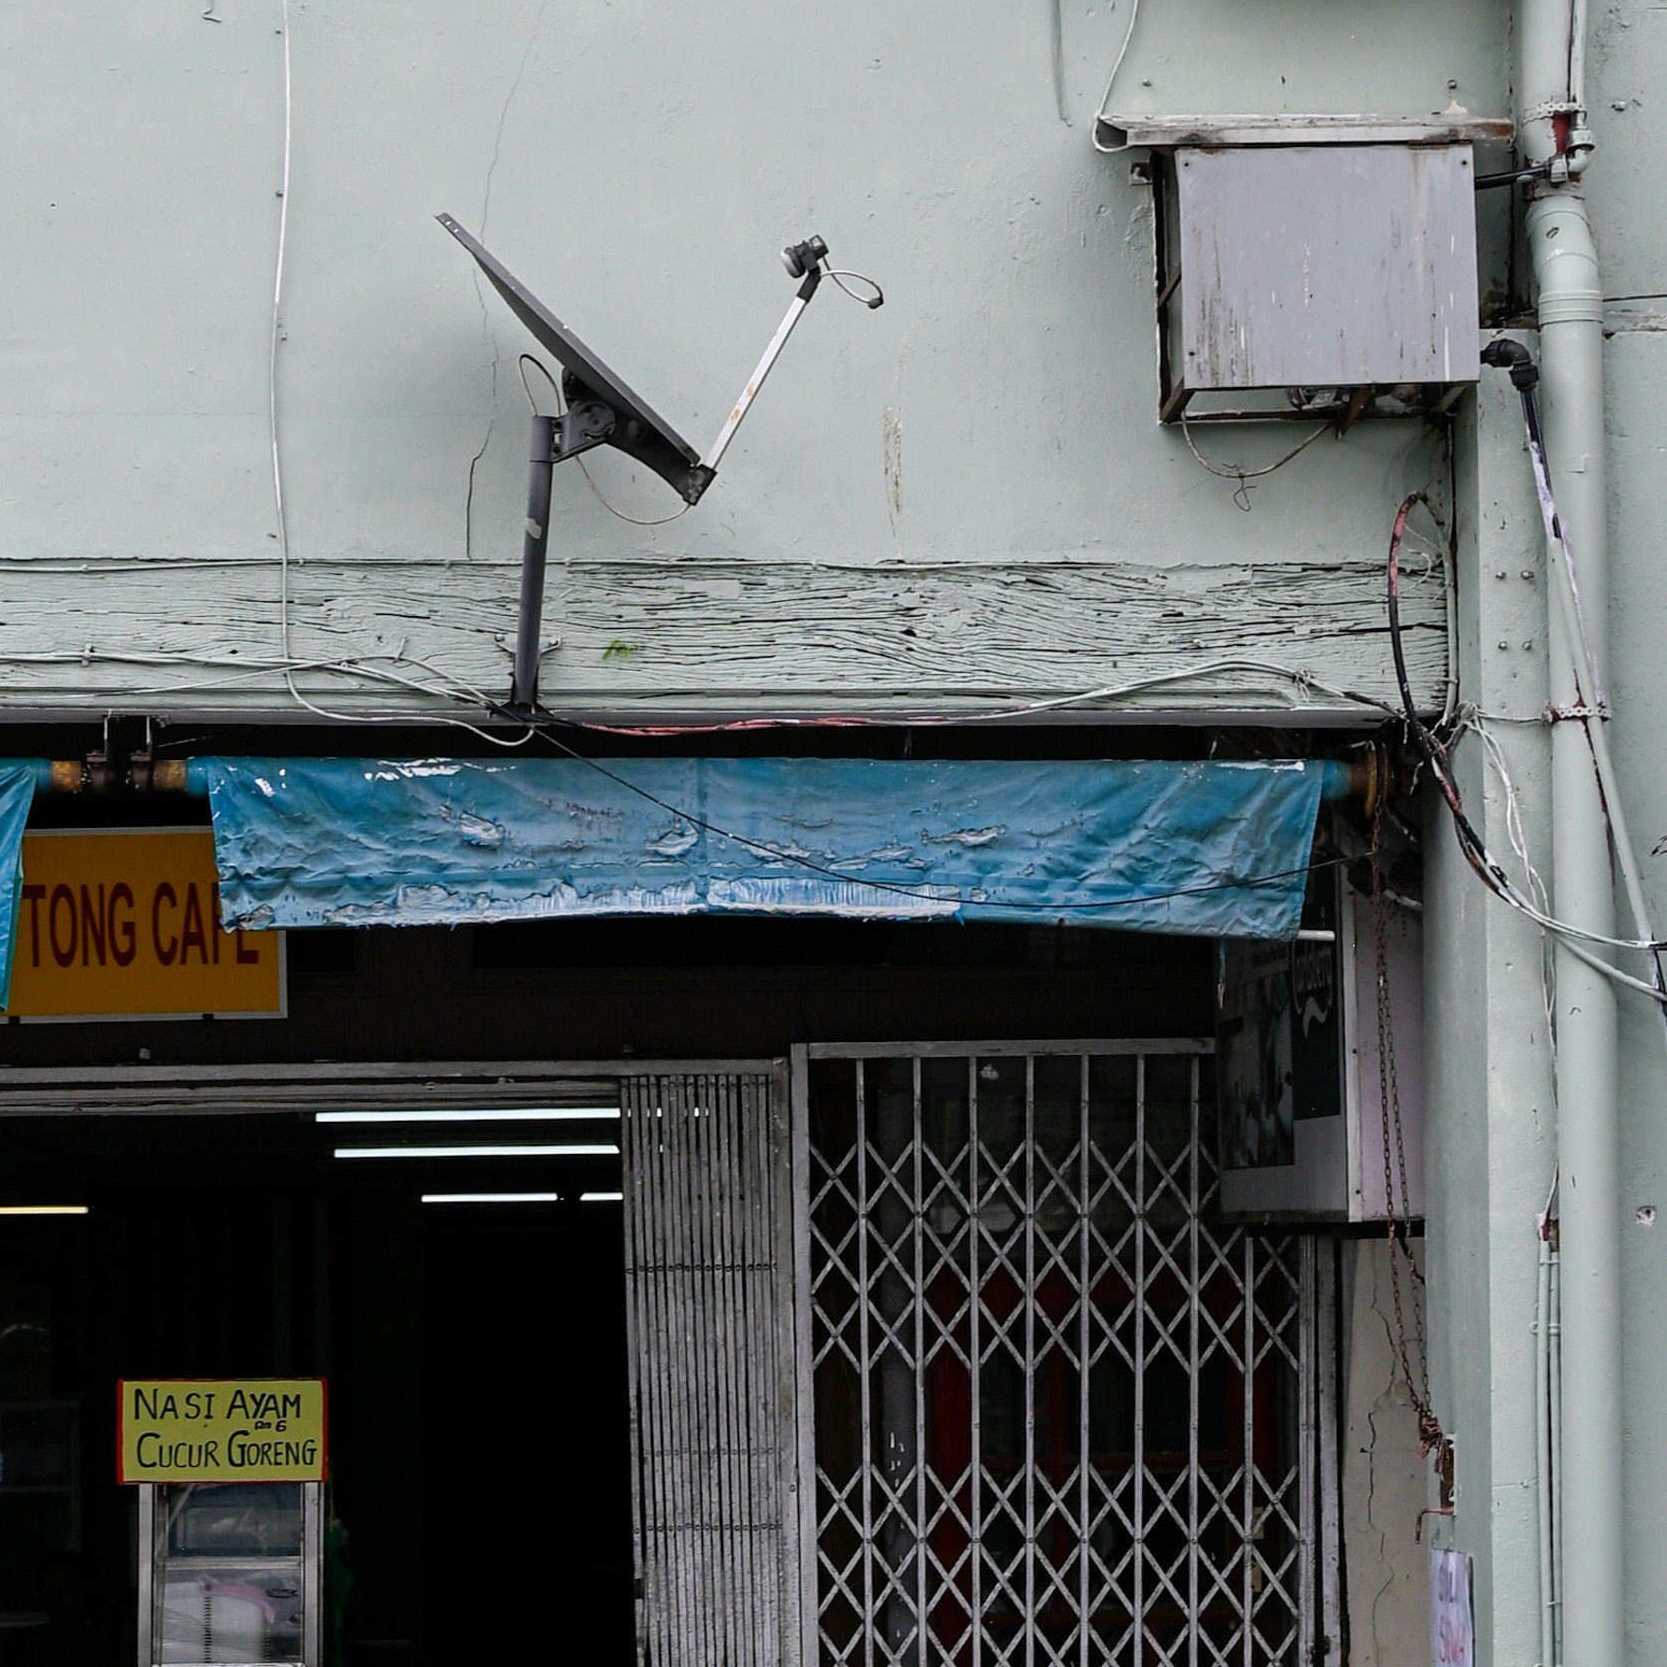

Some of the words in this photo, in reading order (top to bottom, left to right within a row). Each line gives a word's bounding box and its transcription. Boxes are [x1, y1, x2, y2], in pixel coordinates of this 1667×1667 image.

[22, 881, 136, 968] TONG
[134, 1387, 216, 1420] NASI
[226, 1389, 302, 1421] AYAM
[275, 1419, 288, 1433] 6
[137, 1432, 221, 1468] CUCUR
[227, 1429, 318, 1468] GORENG
